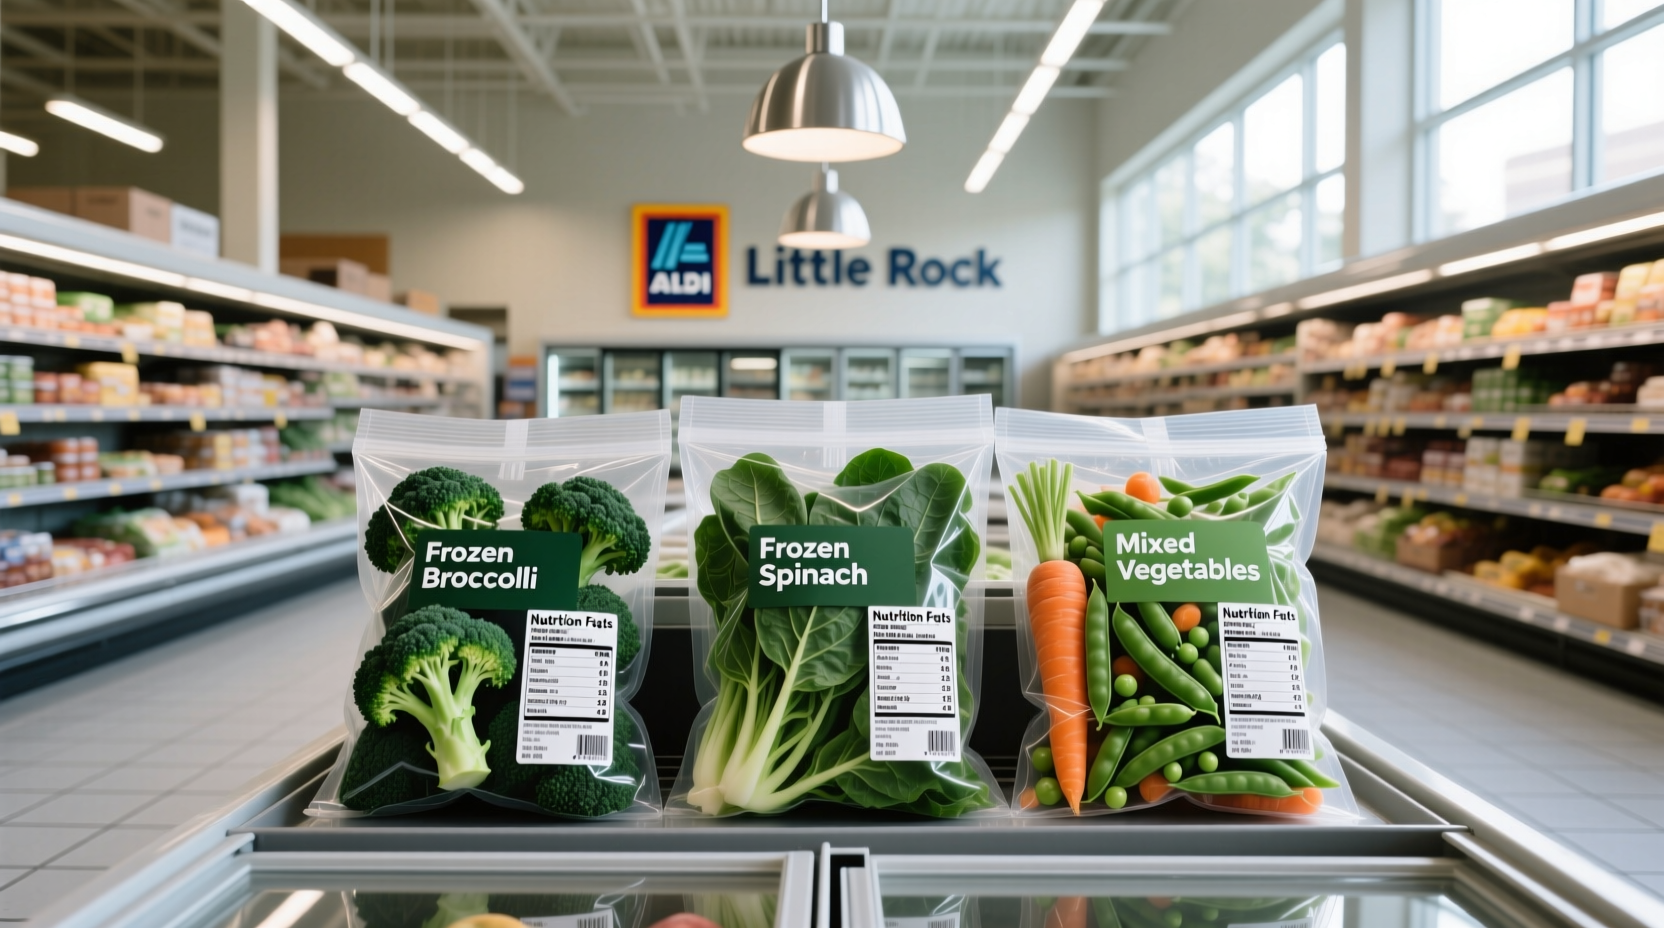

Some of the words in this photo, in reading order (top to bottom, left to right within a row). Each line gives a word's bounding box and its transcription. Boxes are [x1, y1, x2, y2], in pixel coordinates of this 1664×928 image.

[745, 246, 872, 286] Little
[887, 247, 1003, 287] Rock
[649, 271, 711, 295] ALDI
[425, 541, 514, 563] Frozen
[760, 537, 850, 559] Frozen
[1116, 532, 1196, 554] Mixed
[421, 566, 538, 589] Broccolli
[758, 562, 868, 592] Spinach
[1116, 557, 1261, 586] Vegetables
